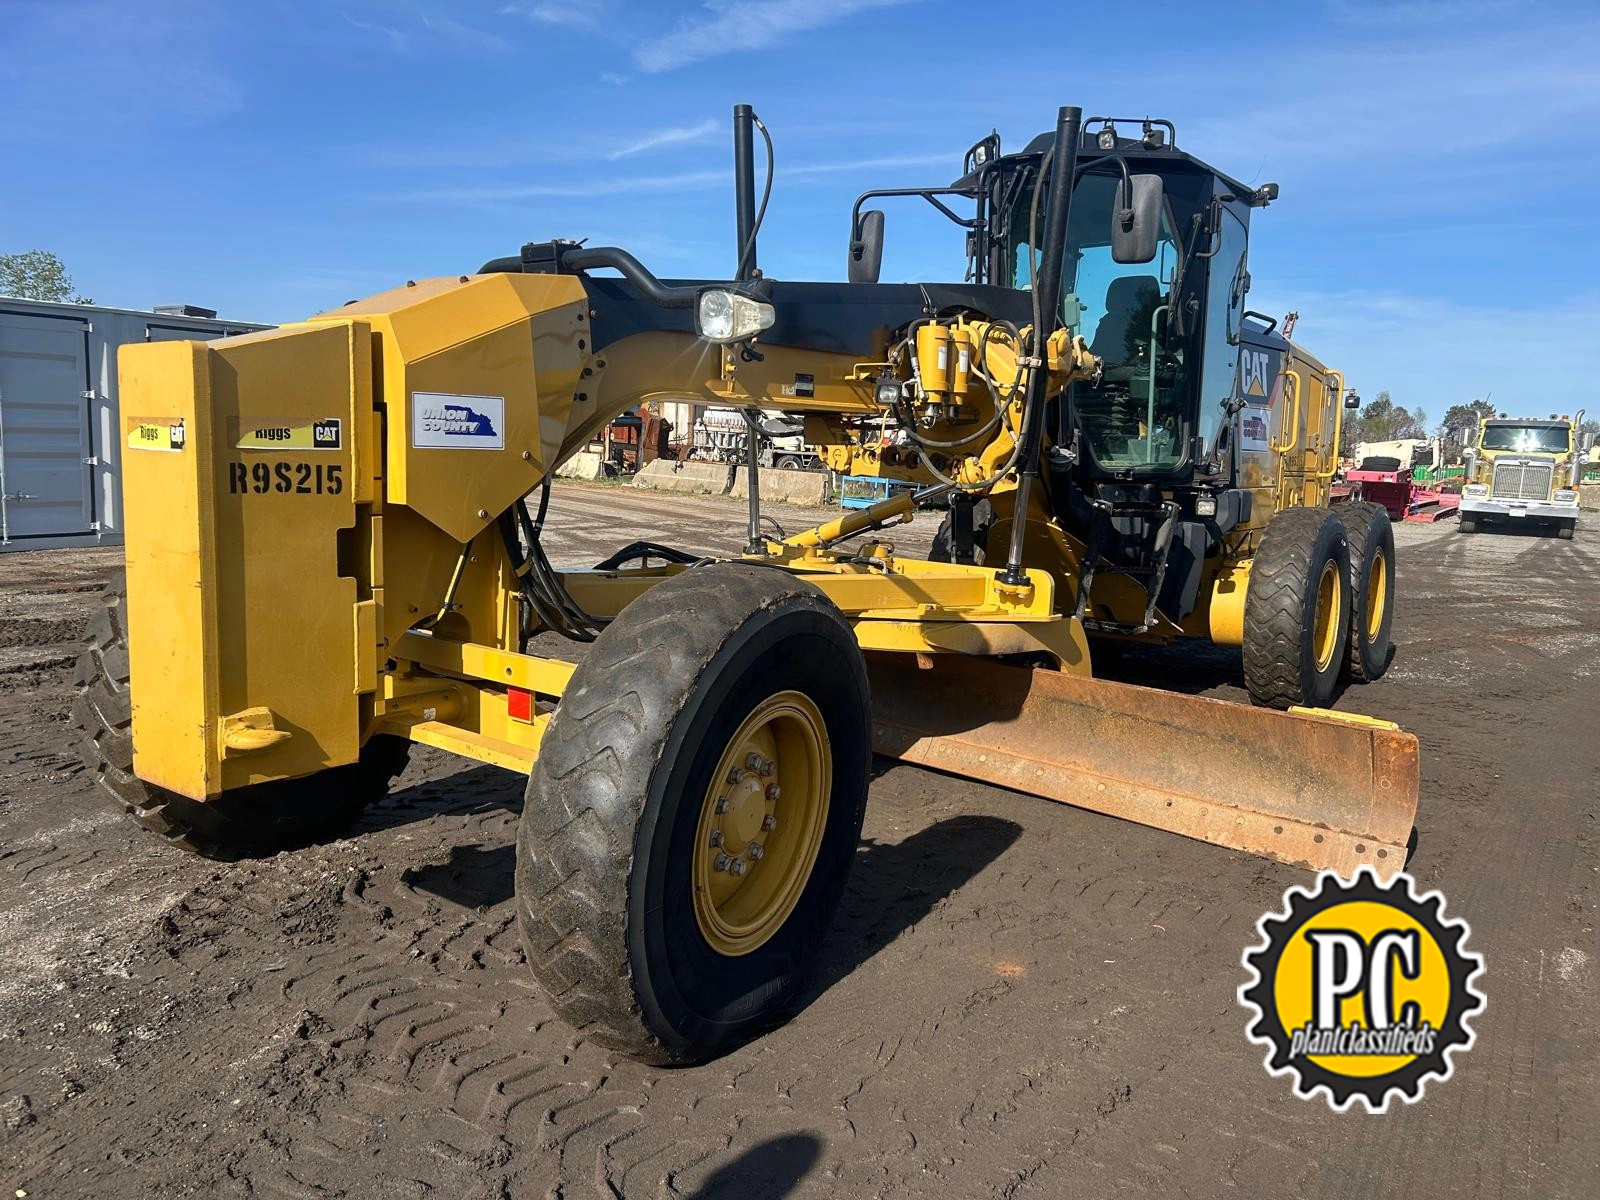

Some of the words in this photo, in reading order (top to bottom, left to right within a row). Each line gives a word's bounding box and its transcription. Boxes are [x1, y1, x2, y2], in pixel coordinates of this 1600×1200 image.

[1241, 348, 1269, 397] CAT
[422, 407, 468, 421] UNION
[140, 425, 158, 441] Riggs
[170, 426, 184, 442] CAT
[255, 428, 291, 441] Riggs
[315, 426, 338, 441] CAT
[423, 420, 480, 433] COUNTY
[229, 462, 342, 495] R9S215
